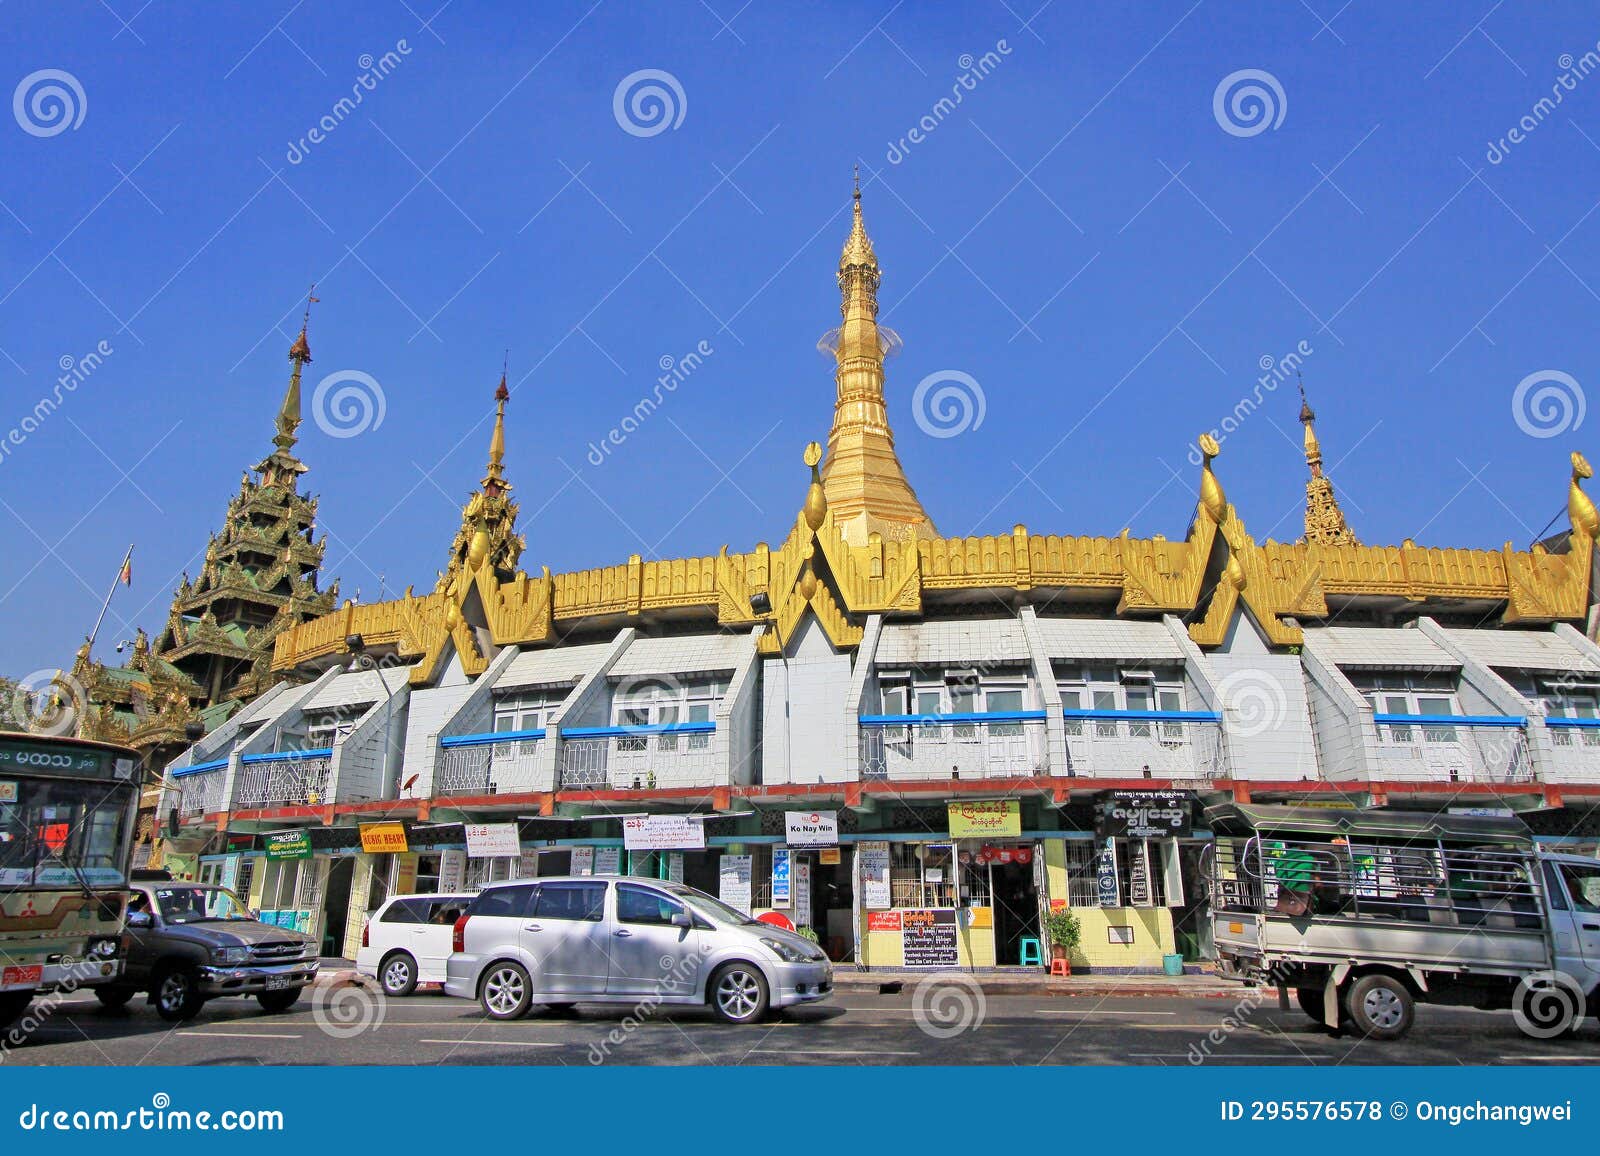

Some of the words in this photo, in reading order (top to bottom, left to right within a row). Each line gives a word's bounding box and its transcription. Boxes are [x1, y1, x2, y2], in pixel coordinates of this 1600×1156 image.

[790, 824, 801, 832] Ko
[803, 825, 817, 833] Nay
[818, 824, 833, 832] Win
[383, 833, 405, 844] HEART
